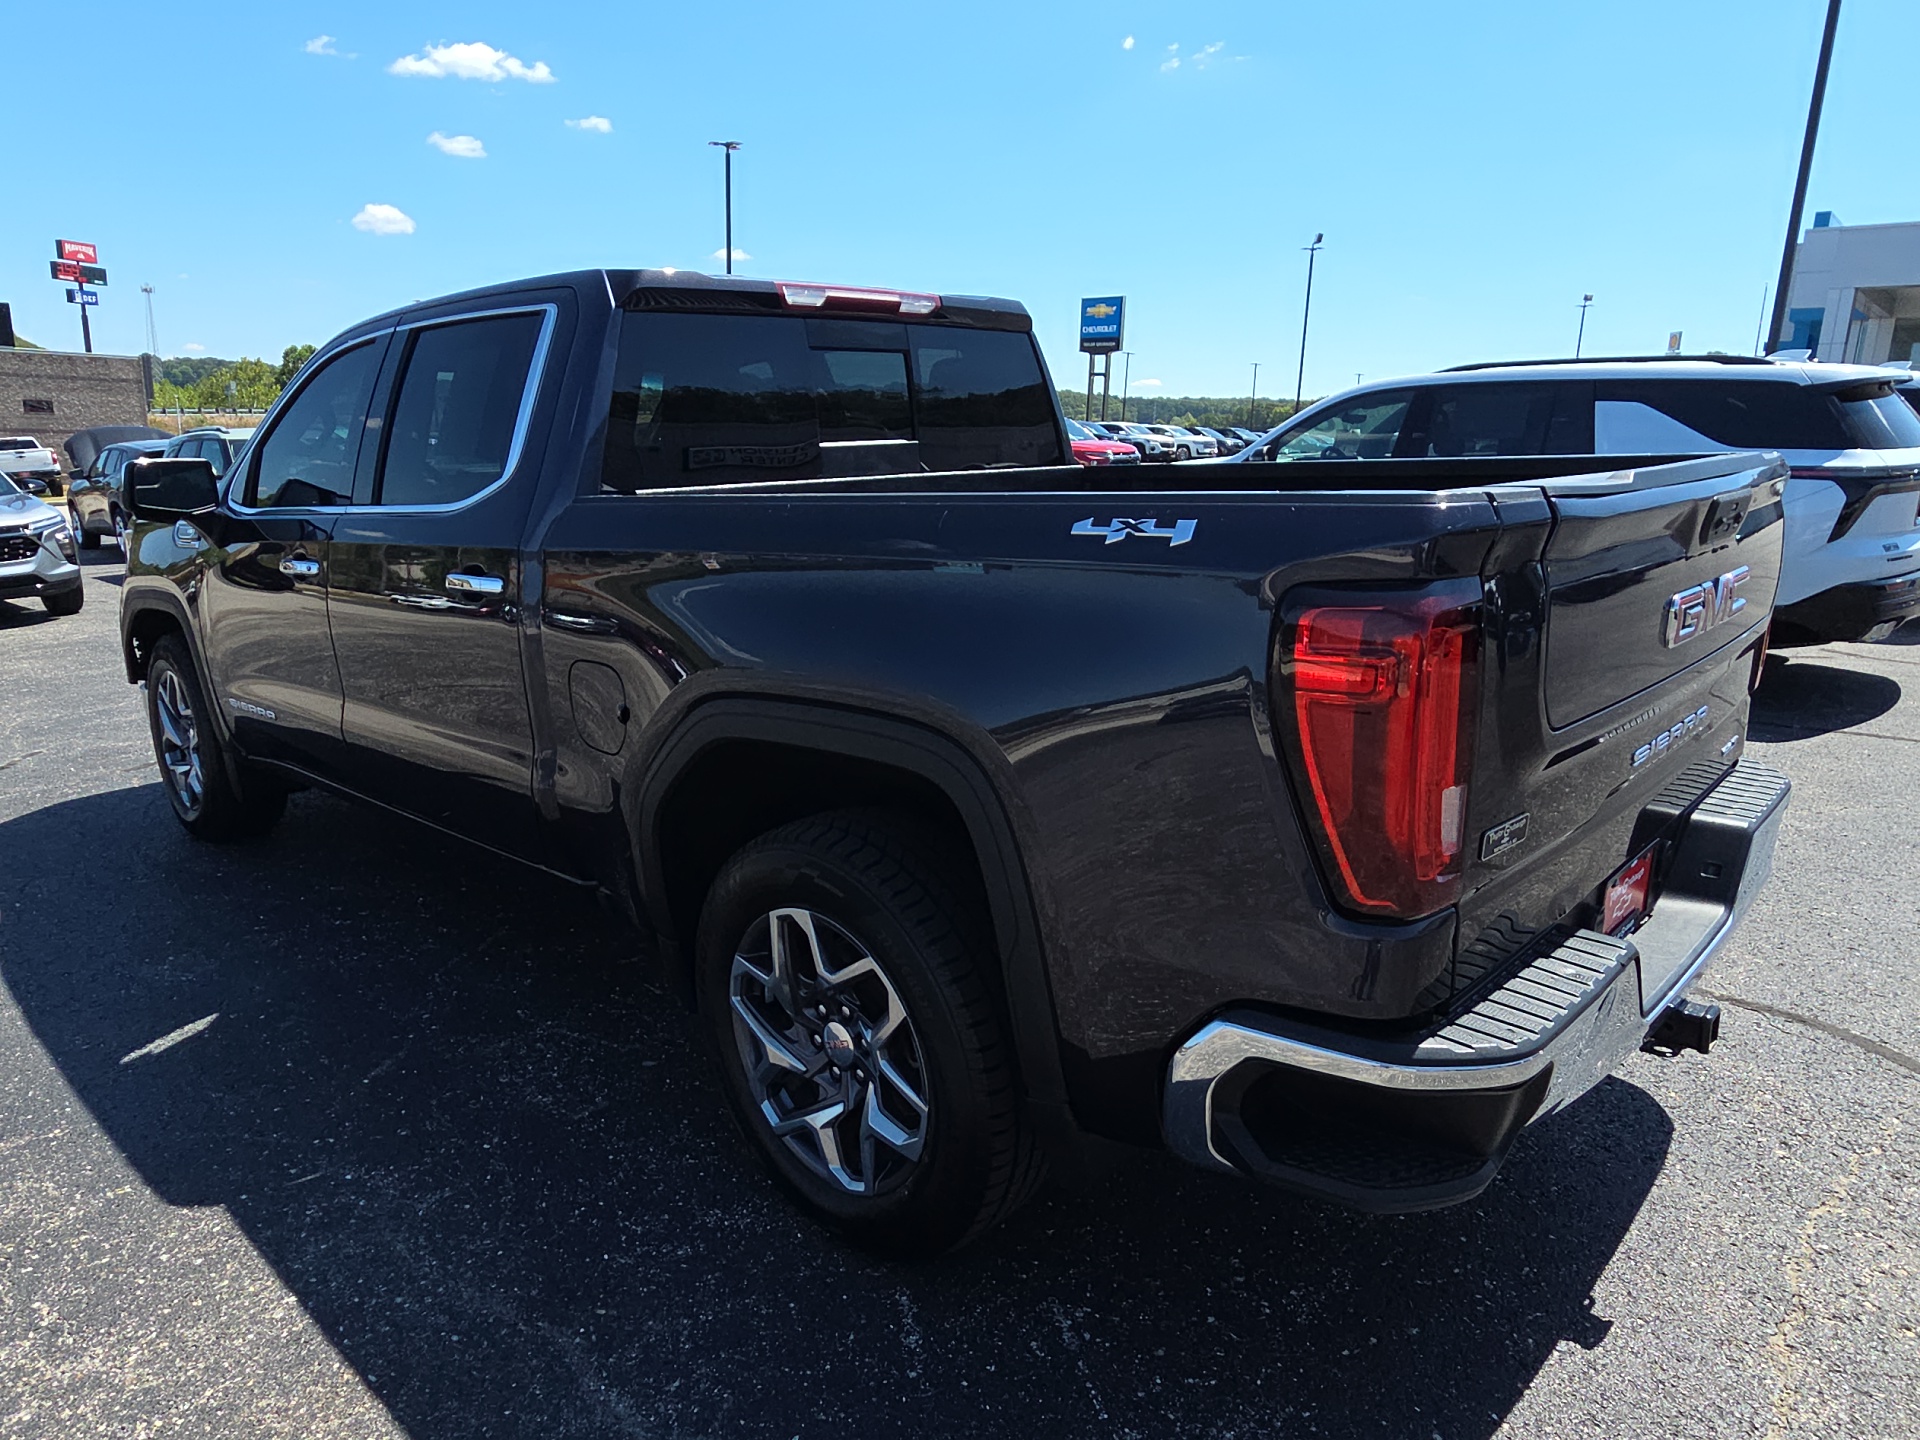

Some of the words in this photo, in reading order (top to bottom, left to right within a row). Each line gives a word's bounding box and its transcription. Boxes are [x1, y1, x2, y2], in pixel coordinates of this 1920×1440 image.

[1082, 325, 1117, 333] CHEVROLET
[1664, 564, 1750, 649] GMC
[228, 698, 277, 720] SIERRA
[1631, 705, 1709, 768] SIERRA
